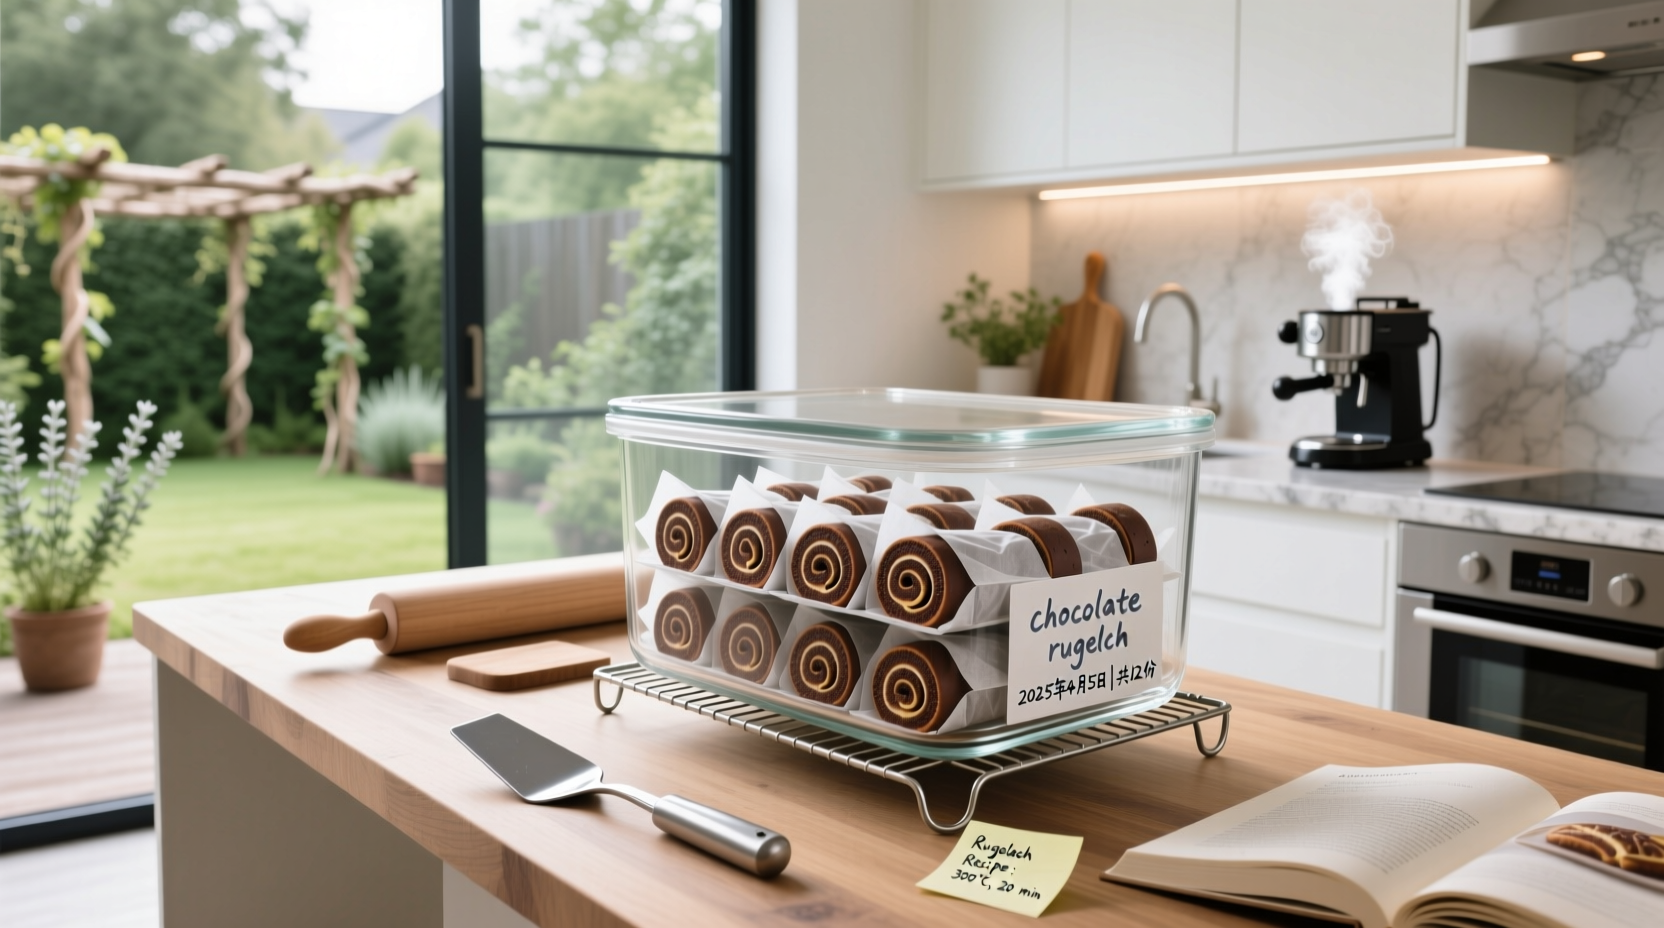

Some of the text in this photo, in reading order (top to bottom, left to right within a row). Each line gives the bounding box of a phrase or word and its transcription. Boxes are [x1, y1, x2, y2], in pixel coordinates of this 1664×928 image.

[1030, 588, 1142, 633] chocolate
[1048, 621, 1128, 670] rugelch
[997, 880, 1015, 892] 20
[1018, 887, 1041, 900] min
